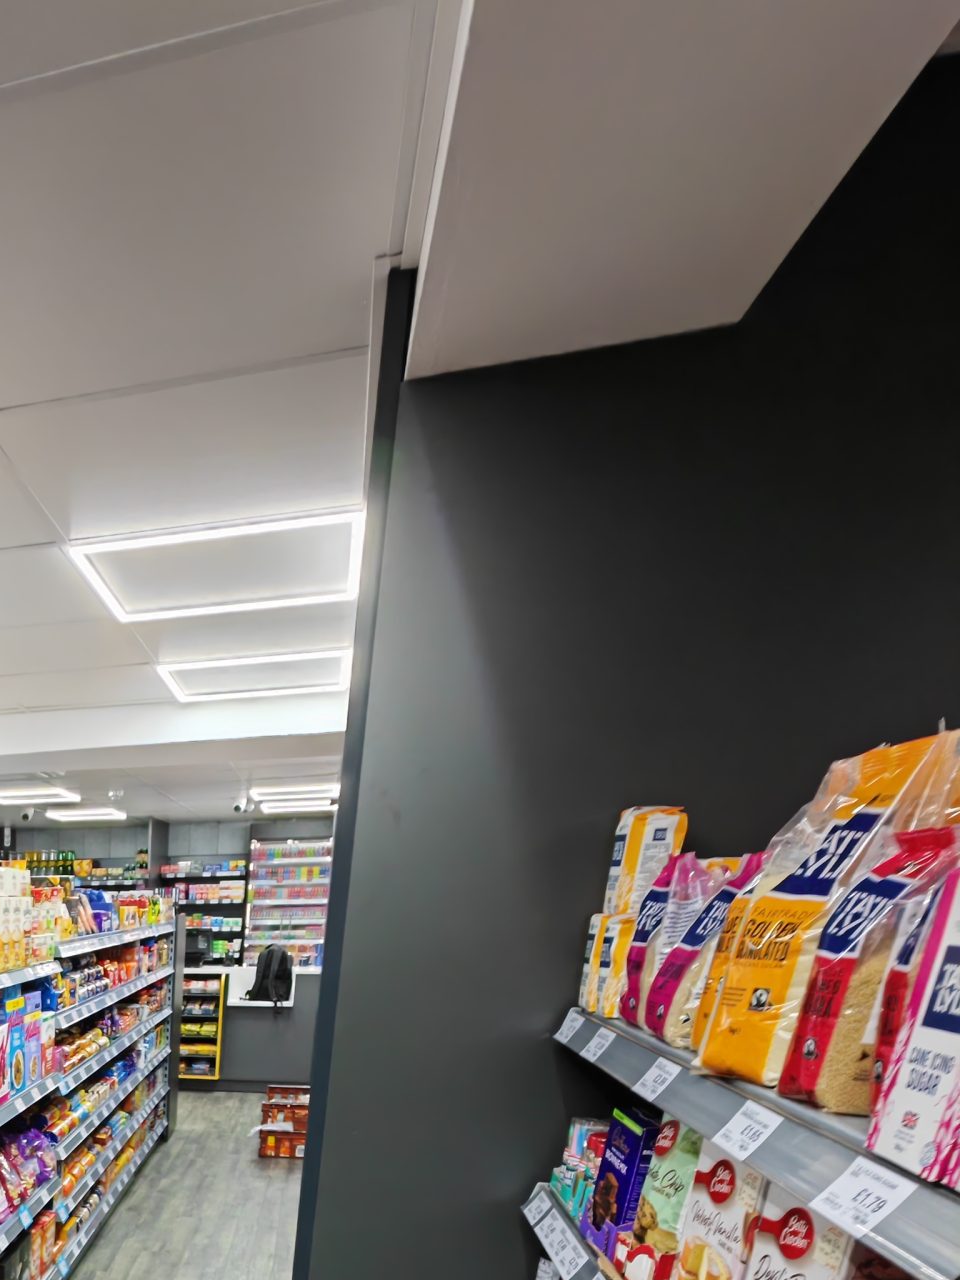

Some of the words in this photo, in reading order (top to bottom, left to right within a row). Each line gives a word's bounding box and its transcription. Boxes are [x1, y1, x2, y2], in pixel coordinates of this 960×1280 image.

[909, 1047, 928, 1065] CANE
[907, 1068, 941, 1097] SUGAR
[660, 1169, 685, 1197] Chip
[852, 1187, 887, 1213] £1.79
[788, 1215, 809, 1236] Betty
[780, 1227, 811, 1249] Crocker
